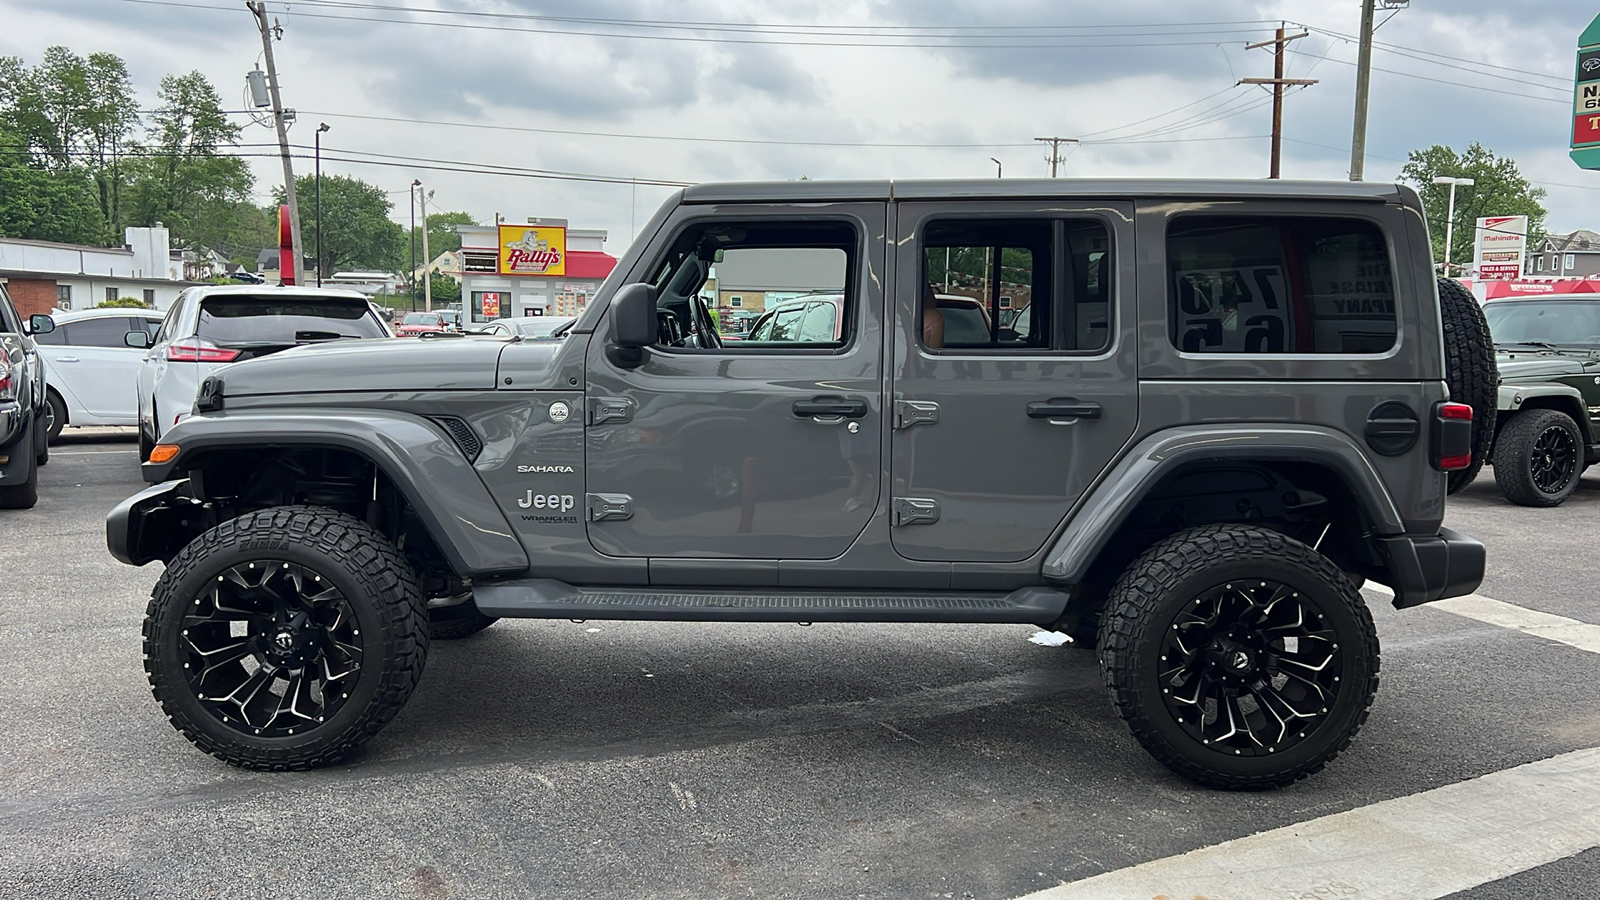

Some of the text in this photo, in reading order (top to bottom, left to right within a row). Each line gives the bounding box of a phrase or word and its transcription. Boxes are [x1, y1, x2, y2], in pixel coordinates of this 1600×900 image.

[1584, 85, 1600, 98] N
[1585, 98, 1600, 109] 6
[507, 247, 561, 271] Rally's
[517, 465, 574, 473] SAHARA
[517, 489, 575, 513] Jeep
